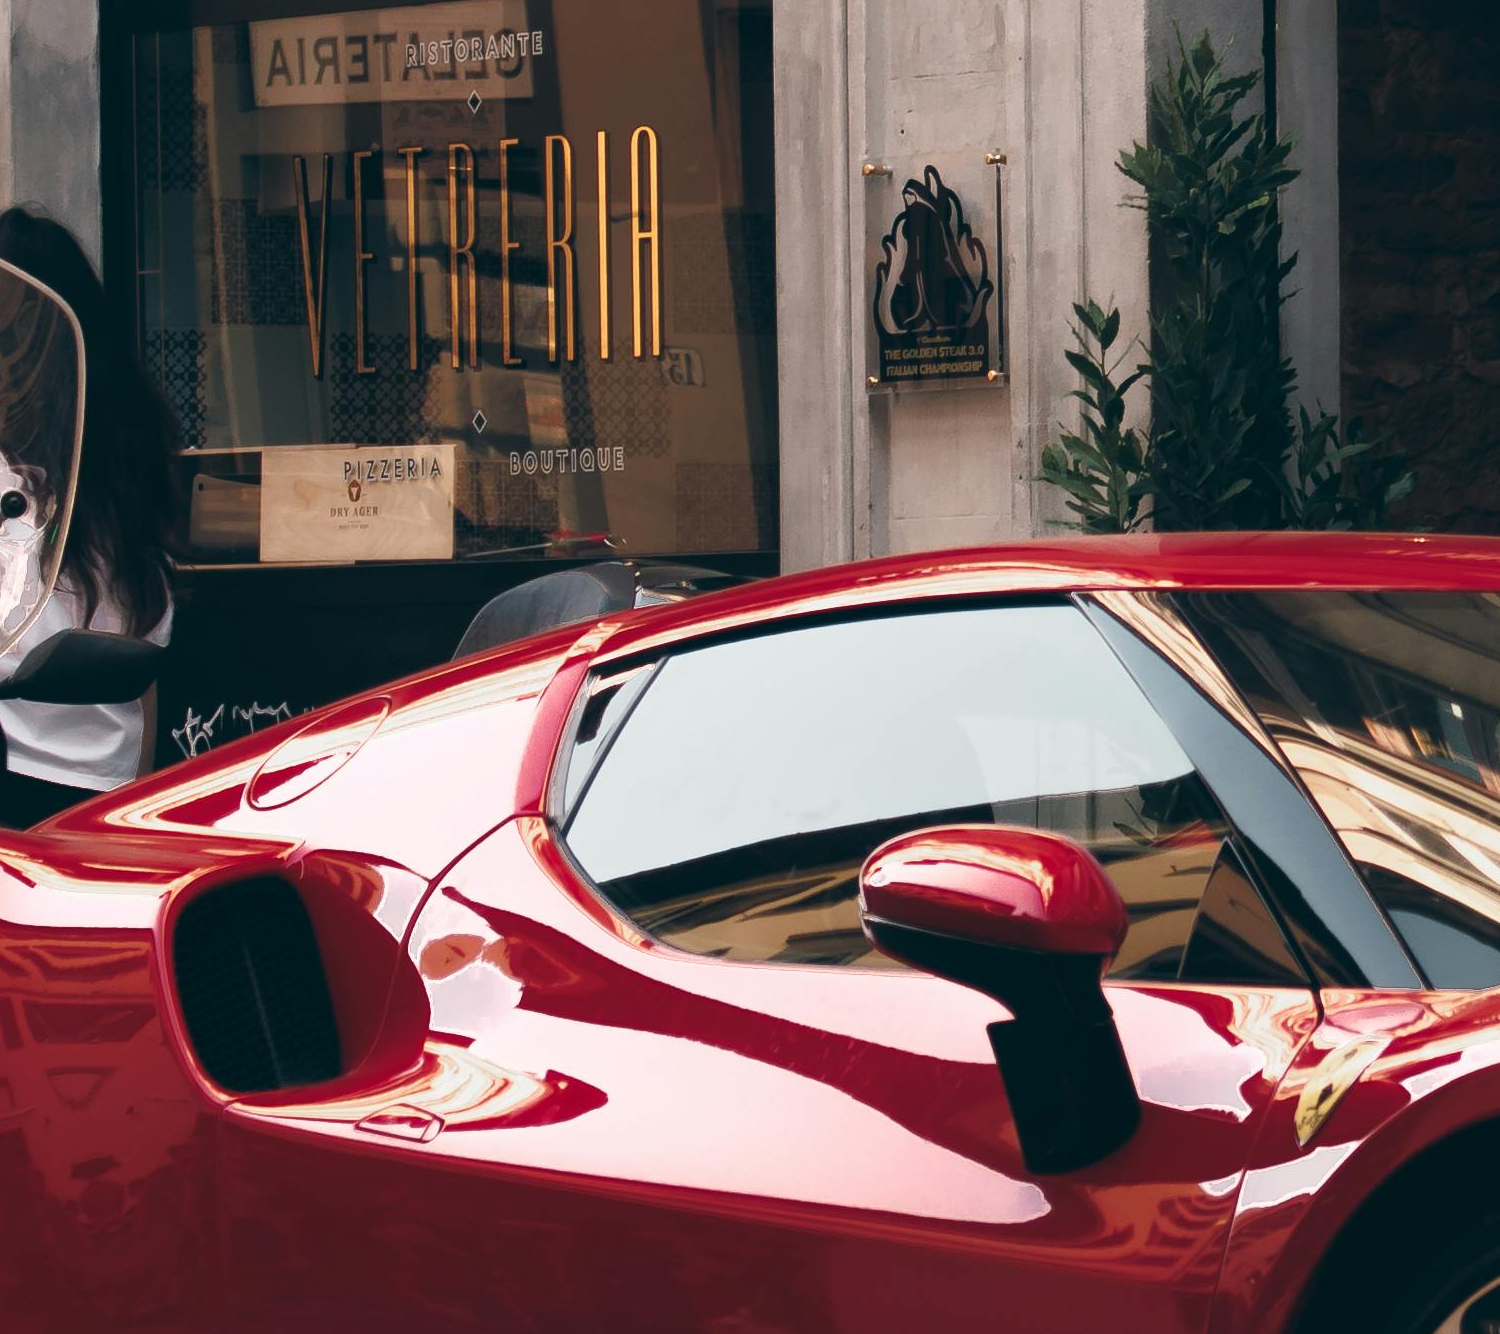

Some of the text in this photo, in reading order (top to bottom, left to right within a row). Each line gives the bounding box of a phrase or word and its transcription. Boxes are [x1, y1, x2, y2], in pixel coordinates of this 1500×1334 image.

[404, 30, 544, 68] RISTORANTE
[294, 125, 663, 377] VETRERIA
[885, 349, 901, 361] THE
[902, 347, 938, 359] GOLDEN
[343, 457, 444, 483] PIZZERIA
[509, 446, 626, 476] BOUTIQUE
[329, 506, 379, 518] DRY AGER
